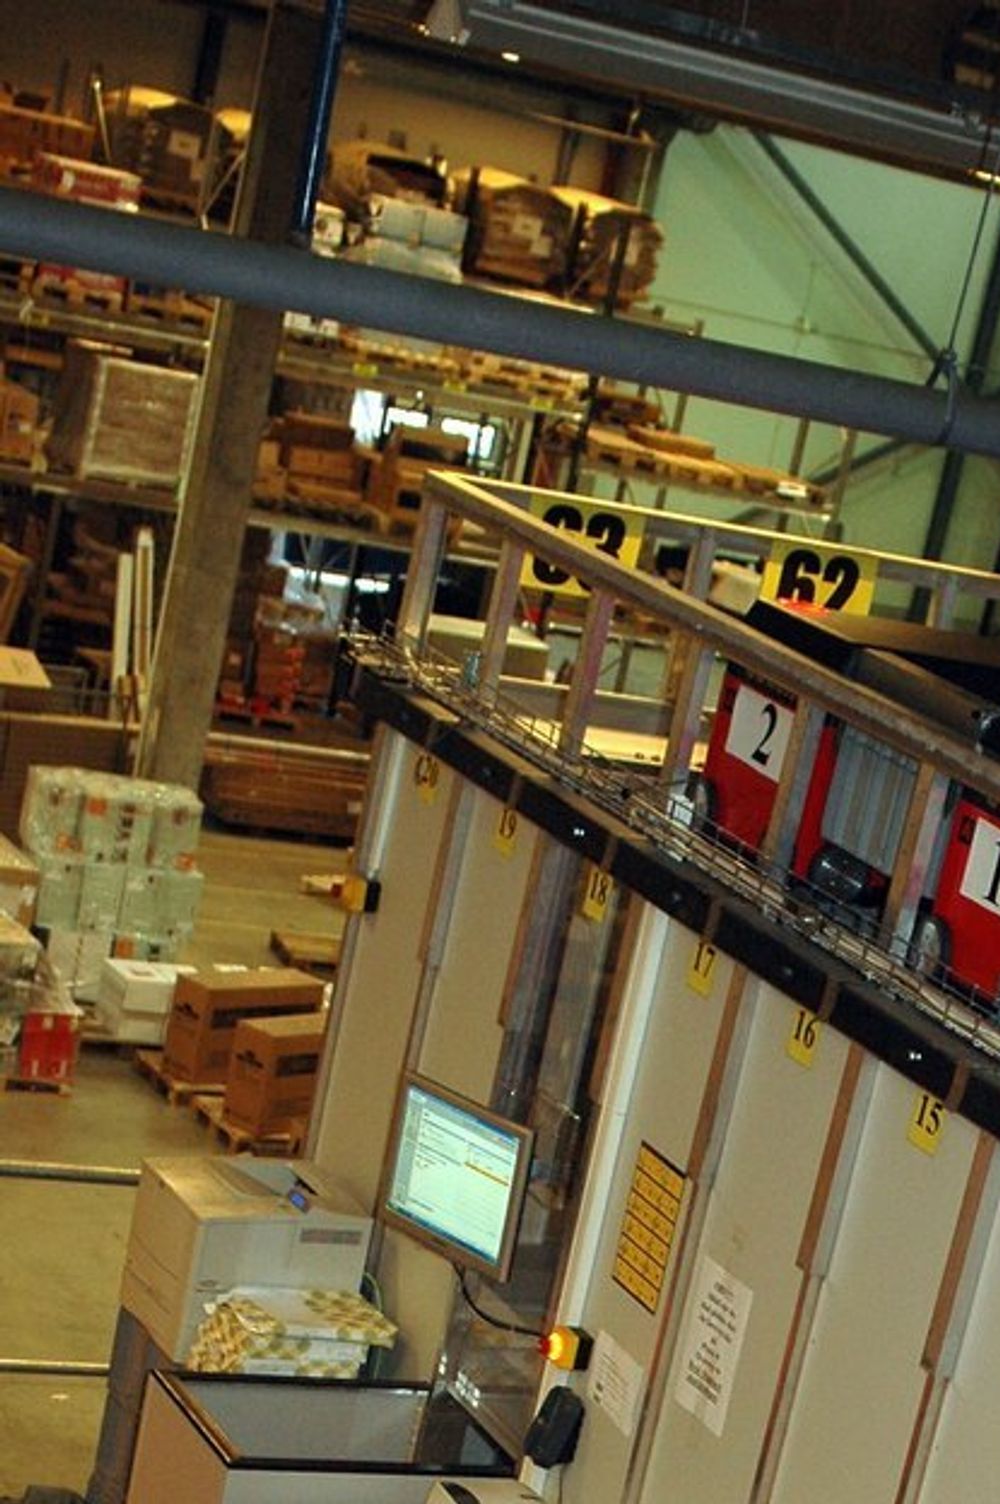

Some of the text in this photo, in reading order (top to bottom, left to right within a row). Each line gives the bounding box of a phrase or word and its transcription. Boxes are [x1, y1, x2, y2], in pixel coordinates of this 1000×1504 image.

[752, 704, 777, 766] 2
[590, 872, 608, 905] 18
[694, 942, 716, 979] 17
[794, 1011, 820, 1049] 16
[916, 1095, 943, 1136] 15
